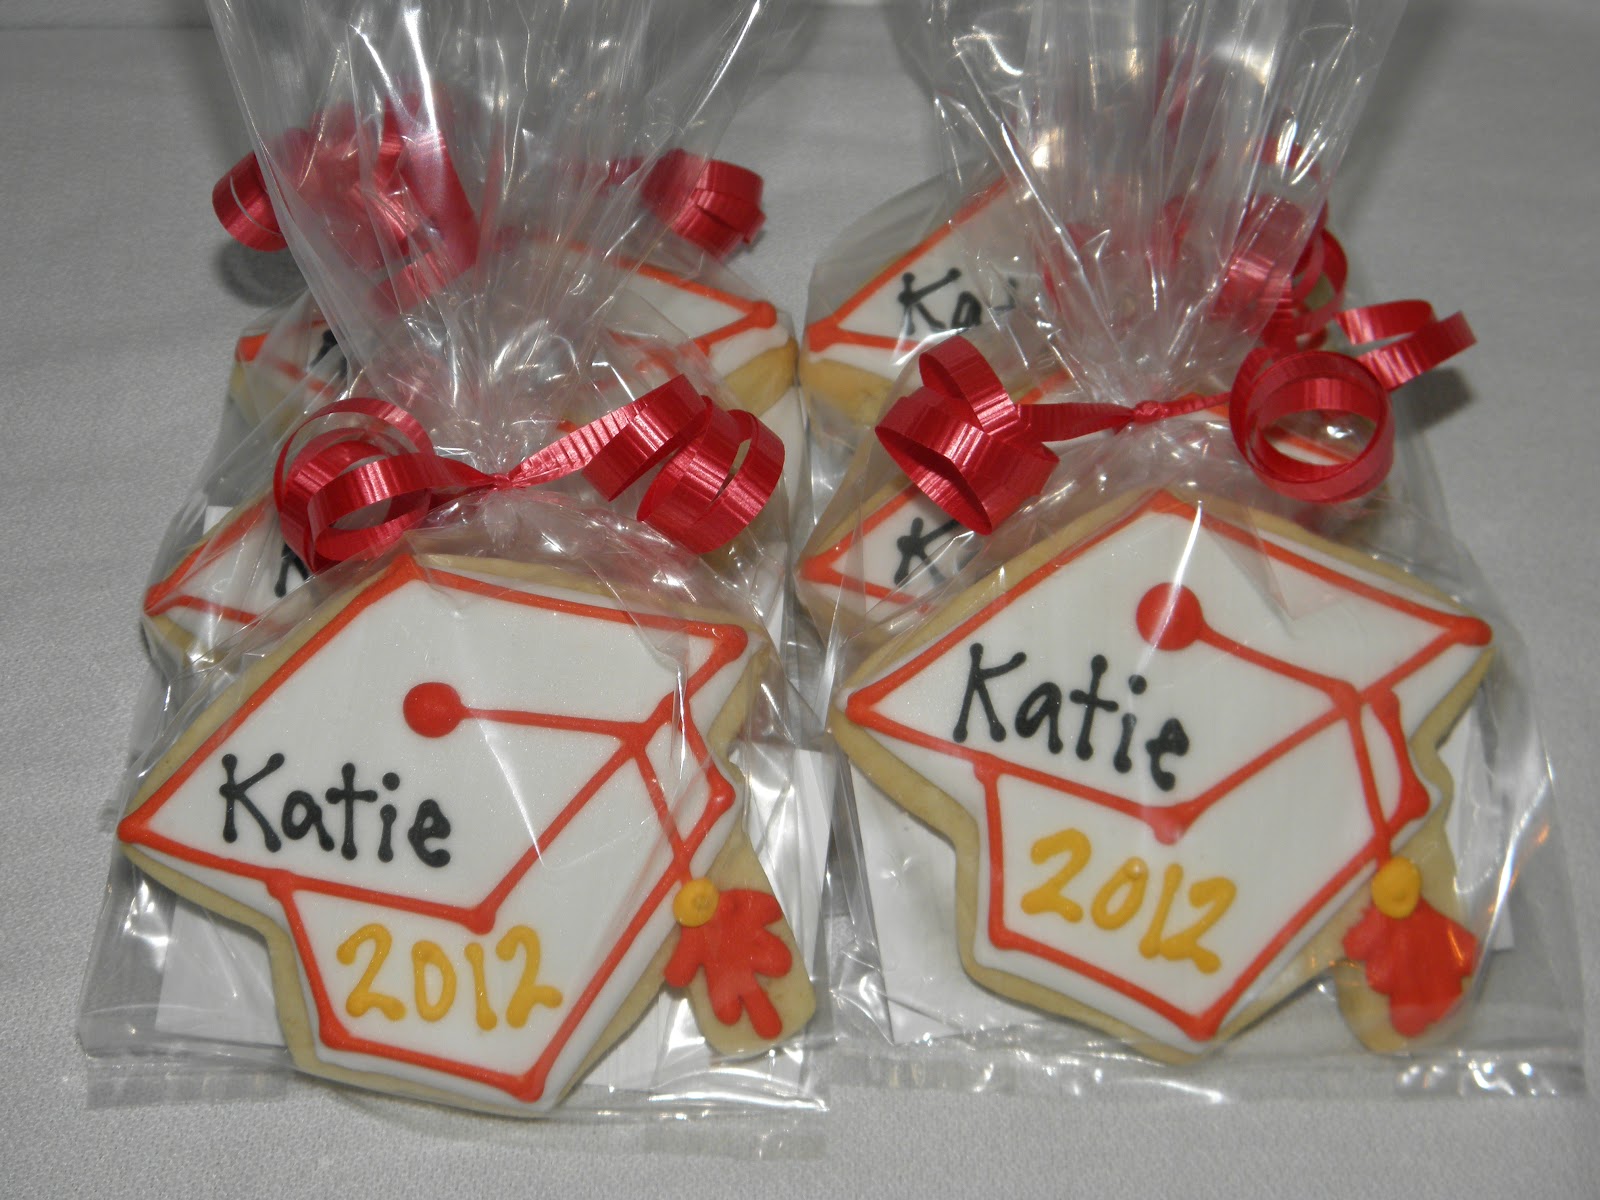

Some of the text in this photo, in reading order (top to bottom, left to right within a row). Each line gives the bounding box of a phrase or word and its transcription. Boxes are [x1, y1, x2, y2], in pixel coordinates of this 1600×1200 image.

[952, 642, 1190, 792] Katie
[219, 752, 452, 868] Katie
[1020, 828, 1237, 974] 2012
[336, 923, 564, 1031] 2012
